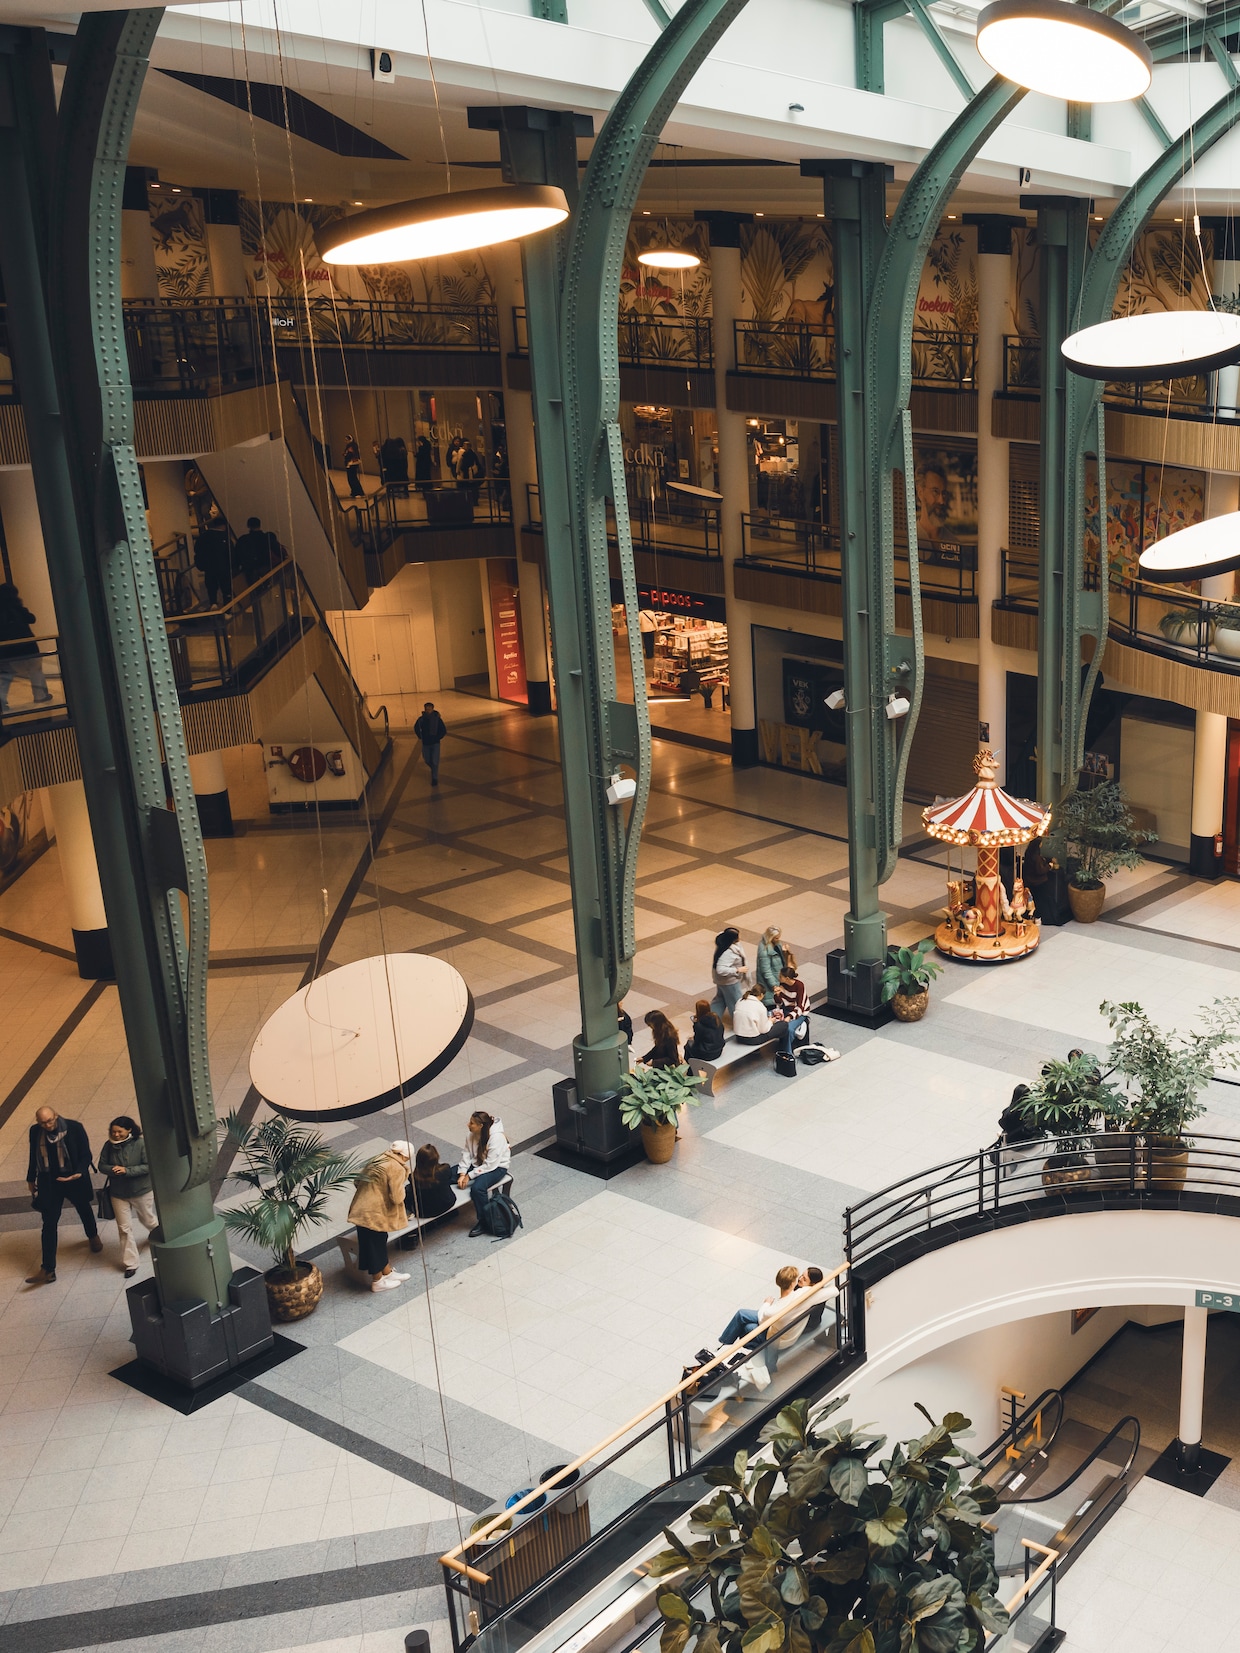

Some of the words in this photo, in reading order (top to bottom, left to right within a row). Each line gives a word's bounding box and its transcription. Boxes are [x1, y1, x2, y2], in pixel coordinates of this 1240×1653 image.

[918, 294, 955, 313] toekan
[793, 679, 809, 689] VEK
[760, 718, 824, 776] VEK
